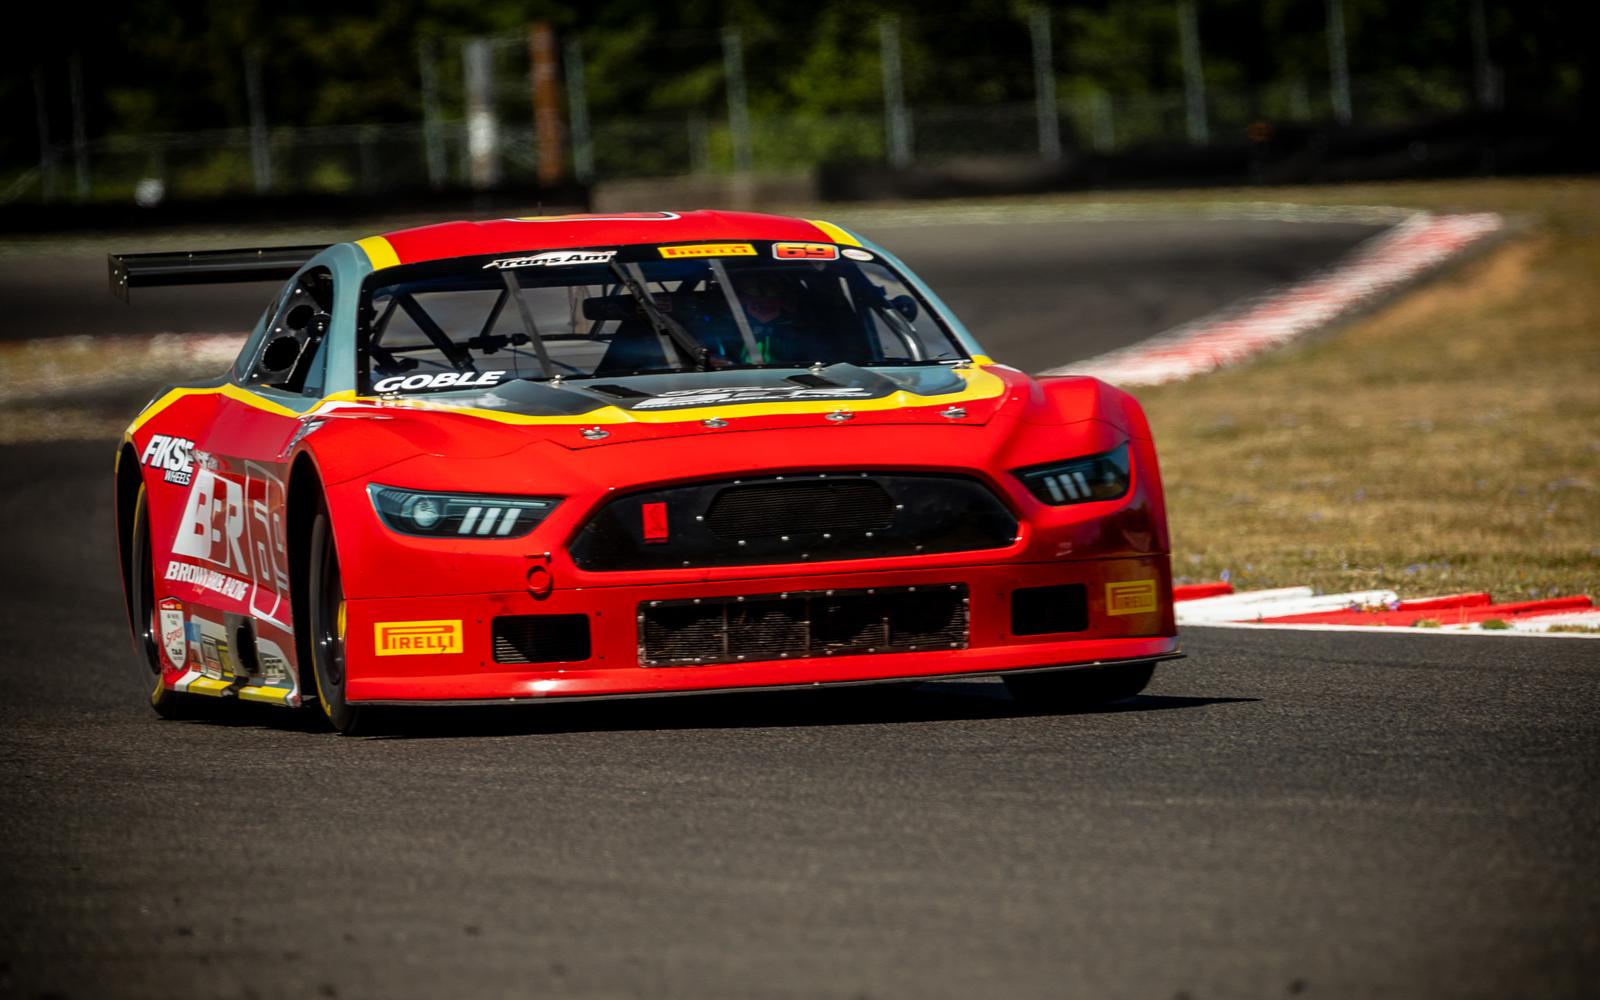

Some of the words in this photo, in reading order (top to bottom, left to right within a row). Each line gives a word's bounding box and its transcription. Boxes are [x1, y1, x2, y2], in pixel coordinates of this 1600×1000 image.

[666, 244, 749, 256] PIRELLI
[776, 244, 836, 258] 69
[497, 257, 562, 268] Trans
[563, 254, 609, 263] Am
[373, 371, 506, 392] GOBLE
[141, 434, 195, 473] FIKSE
[164, 470, 192, 486] WHEELS
[172, 468, 248, 576] BER
[382, 625, 454, 650] PIRELLI
